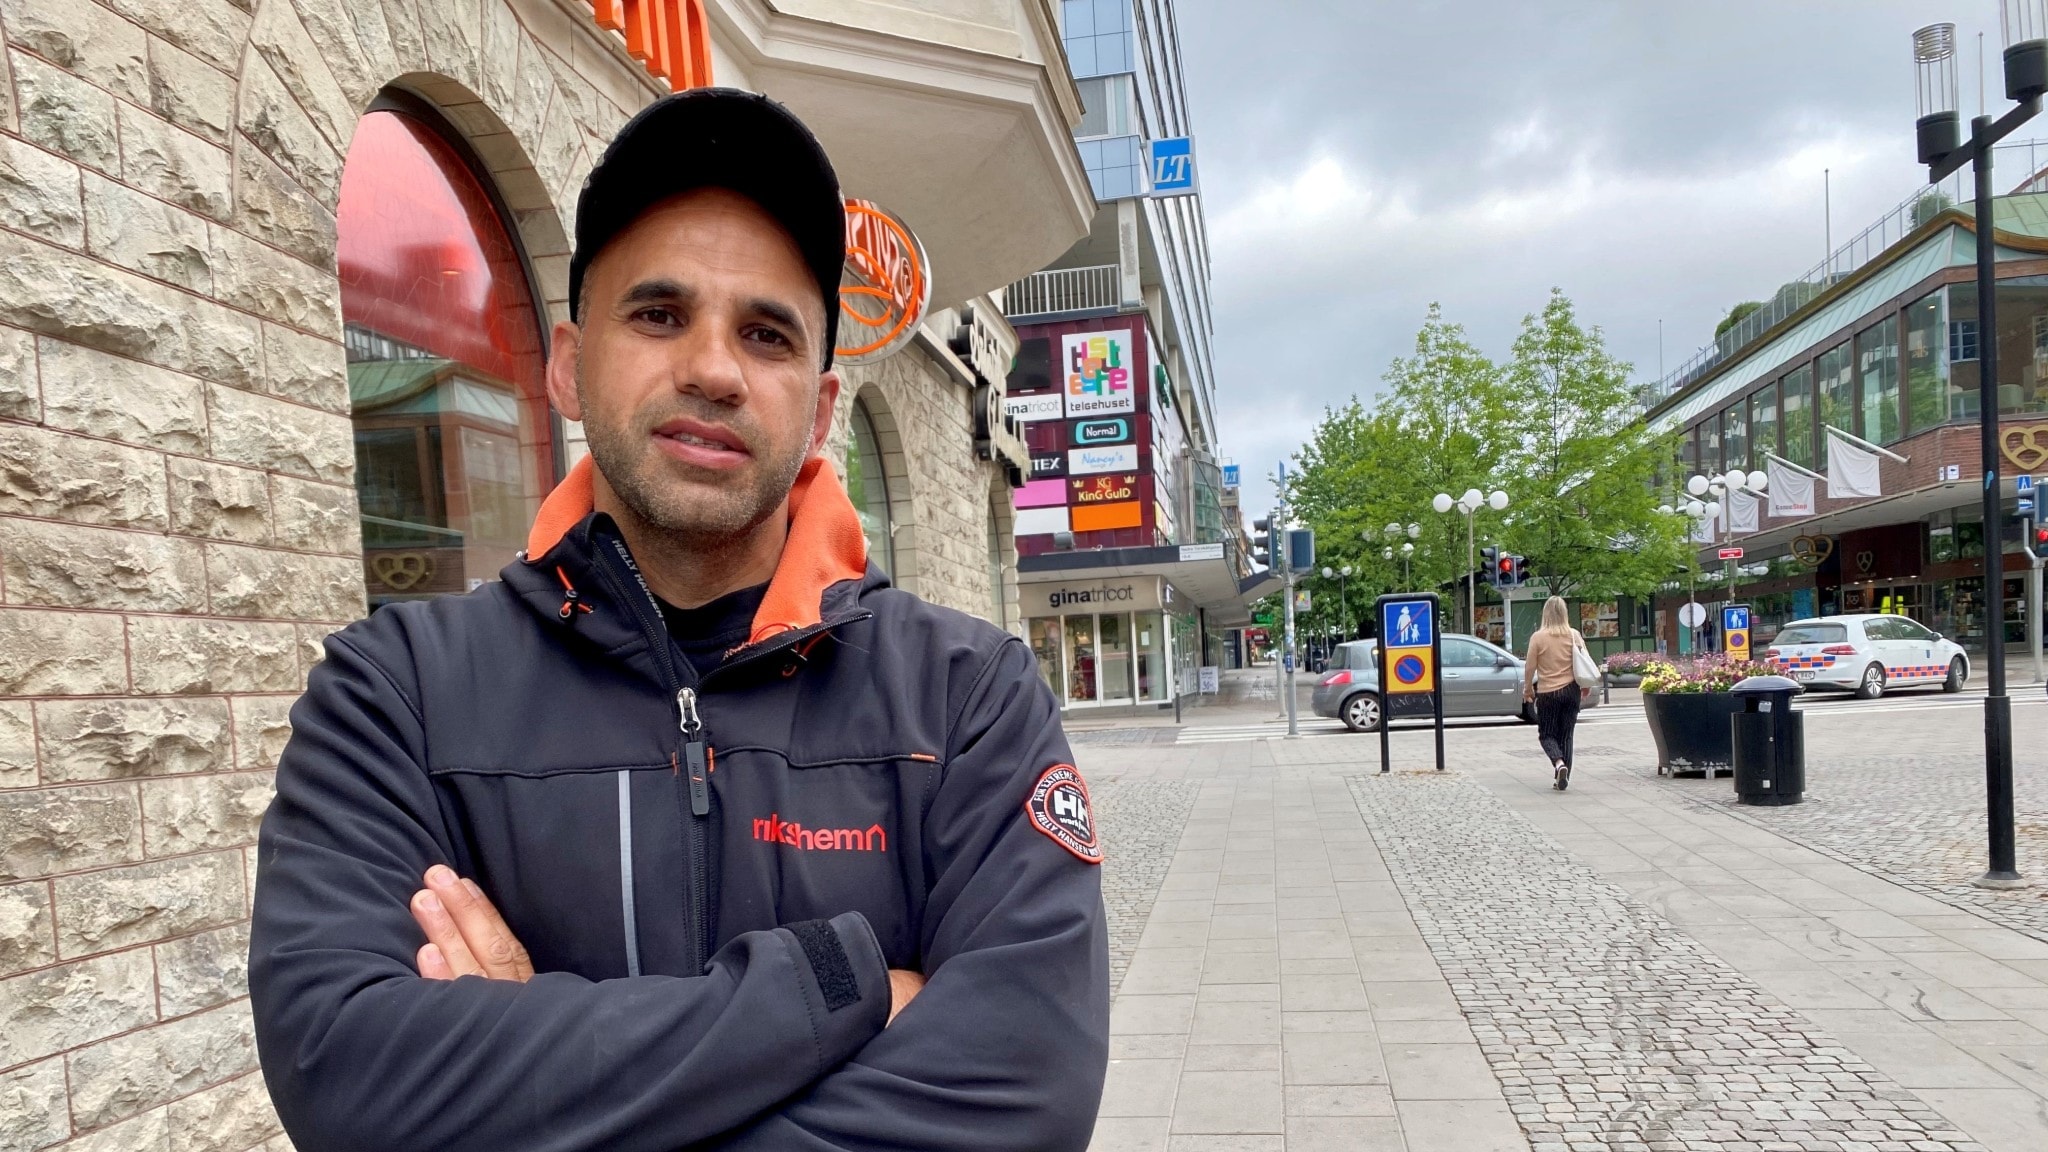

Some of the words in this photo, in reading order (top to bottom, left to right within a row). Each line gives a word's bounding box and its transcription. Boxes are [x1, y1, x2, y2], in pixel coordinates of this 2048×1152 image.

[1153, 153, 1193, 184] LT
[1004, 400, 1060, 415] inatricot
[1070, 398, 1130, 412] telgehuset
[1086, 425, 1117, 438] Normal
[1097, 476, 1112, 490] KG
[612, 540, 638, 570] HELLY
[634, 574, 664, 618] HANSEN
[1049, 584, 1134, 608] ginatricot
[1041, 770, 1074, 788] EXTREME
[1035, 811, 1059, 832] HELLY
[1057, 831, 1089, 855] HANSEN
